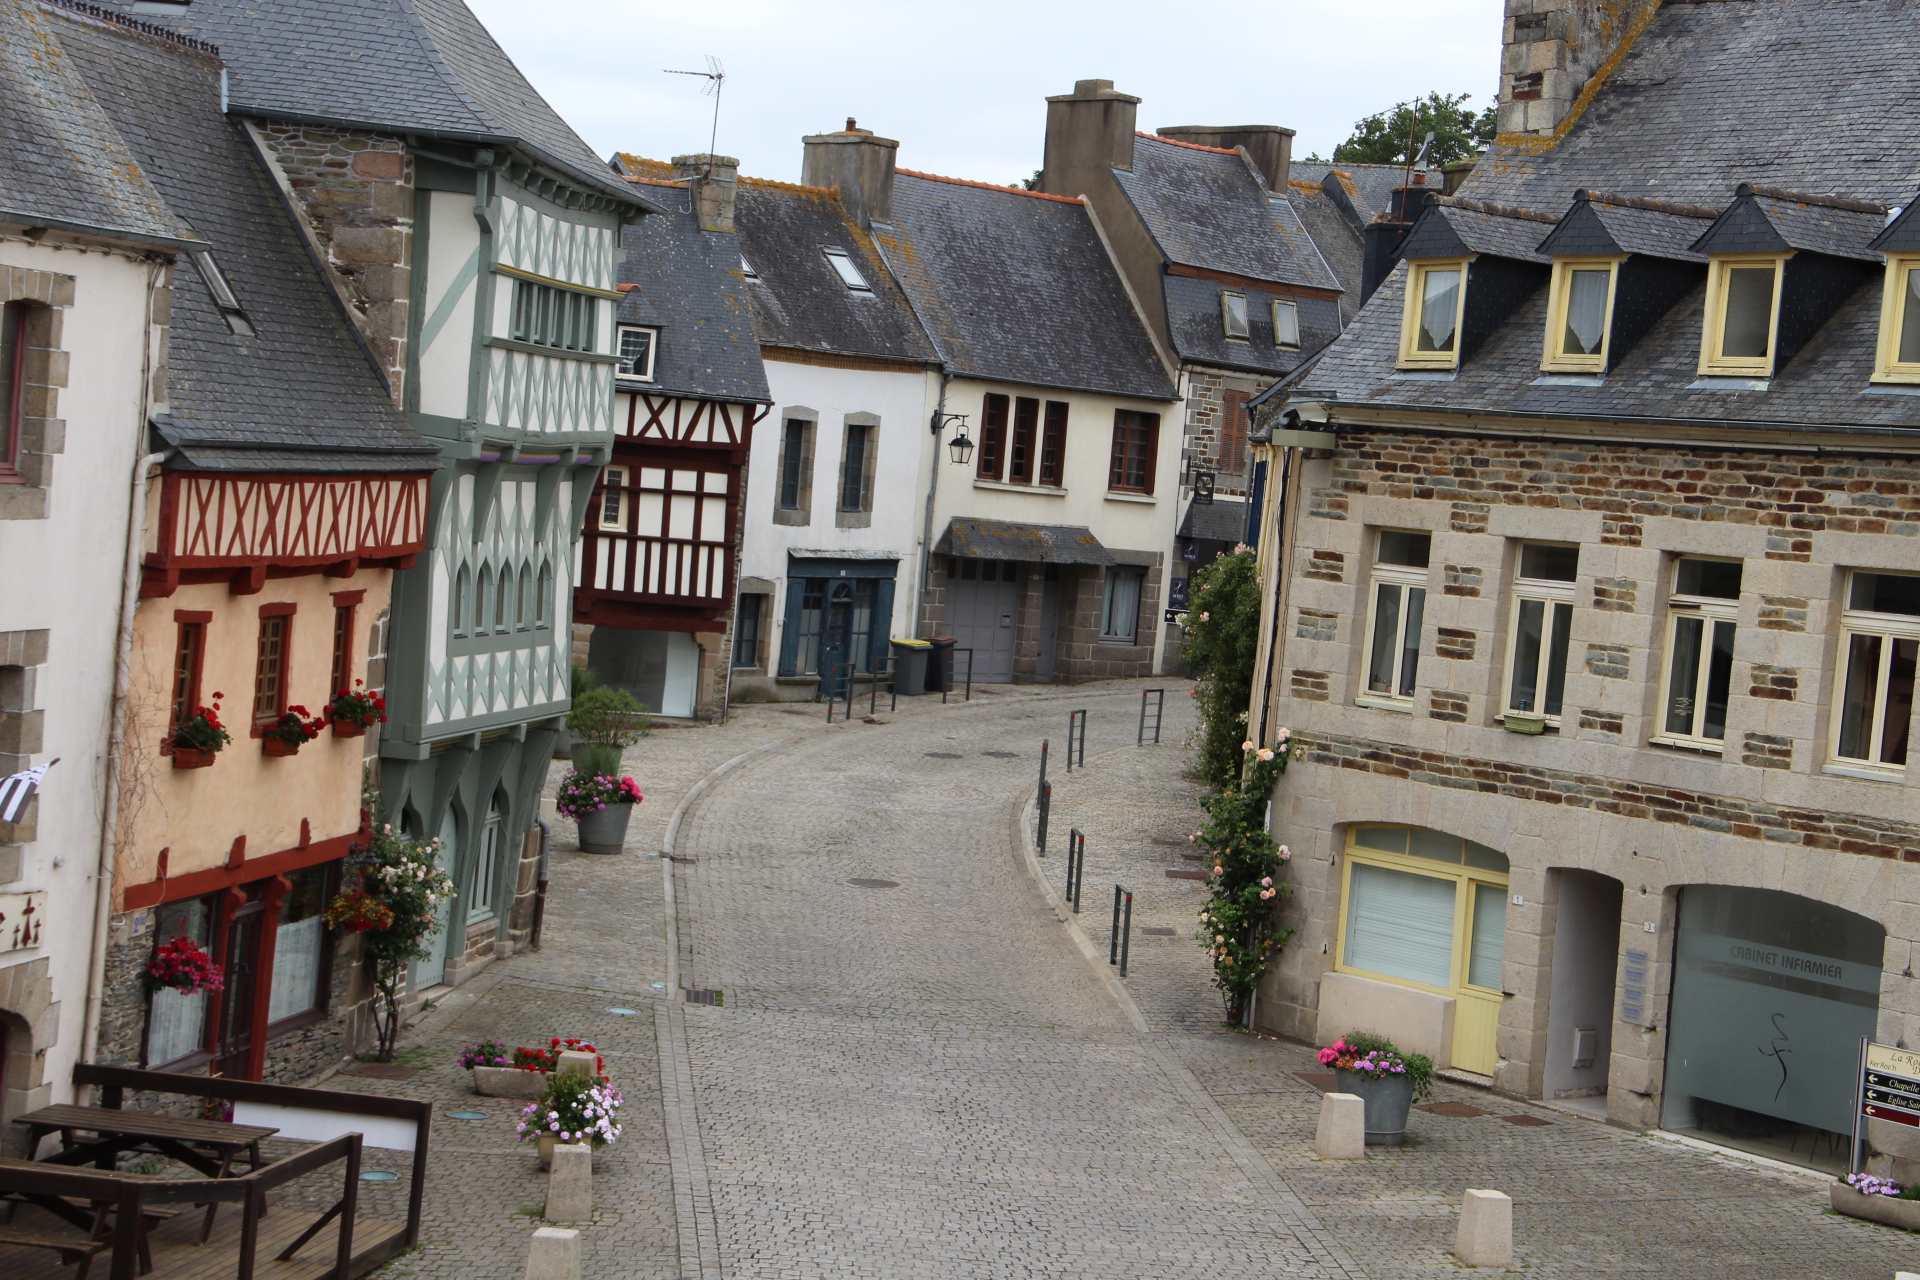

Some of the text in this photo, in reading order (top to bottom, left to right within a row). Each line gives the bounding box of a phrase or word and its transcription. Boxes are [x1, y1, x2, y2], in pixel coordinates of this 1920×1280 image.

[1730, 945, 1842, 979] CABINET INFIRMIER
[1890, 1053, 1902, 1062] La
[1869, 1060, 1879, 1068] Ker
[1889, 1079, 1919, 1092] Chapelle
[1887, 1094, 1907, 1106] Église
